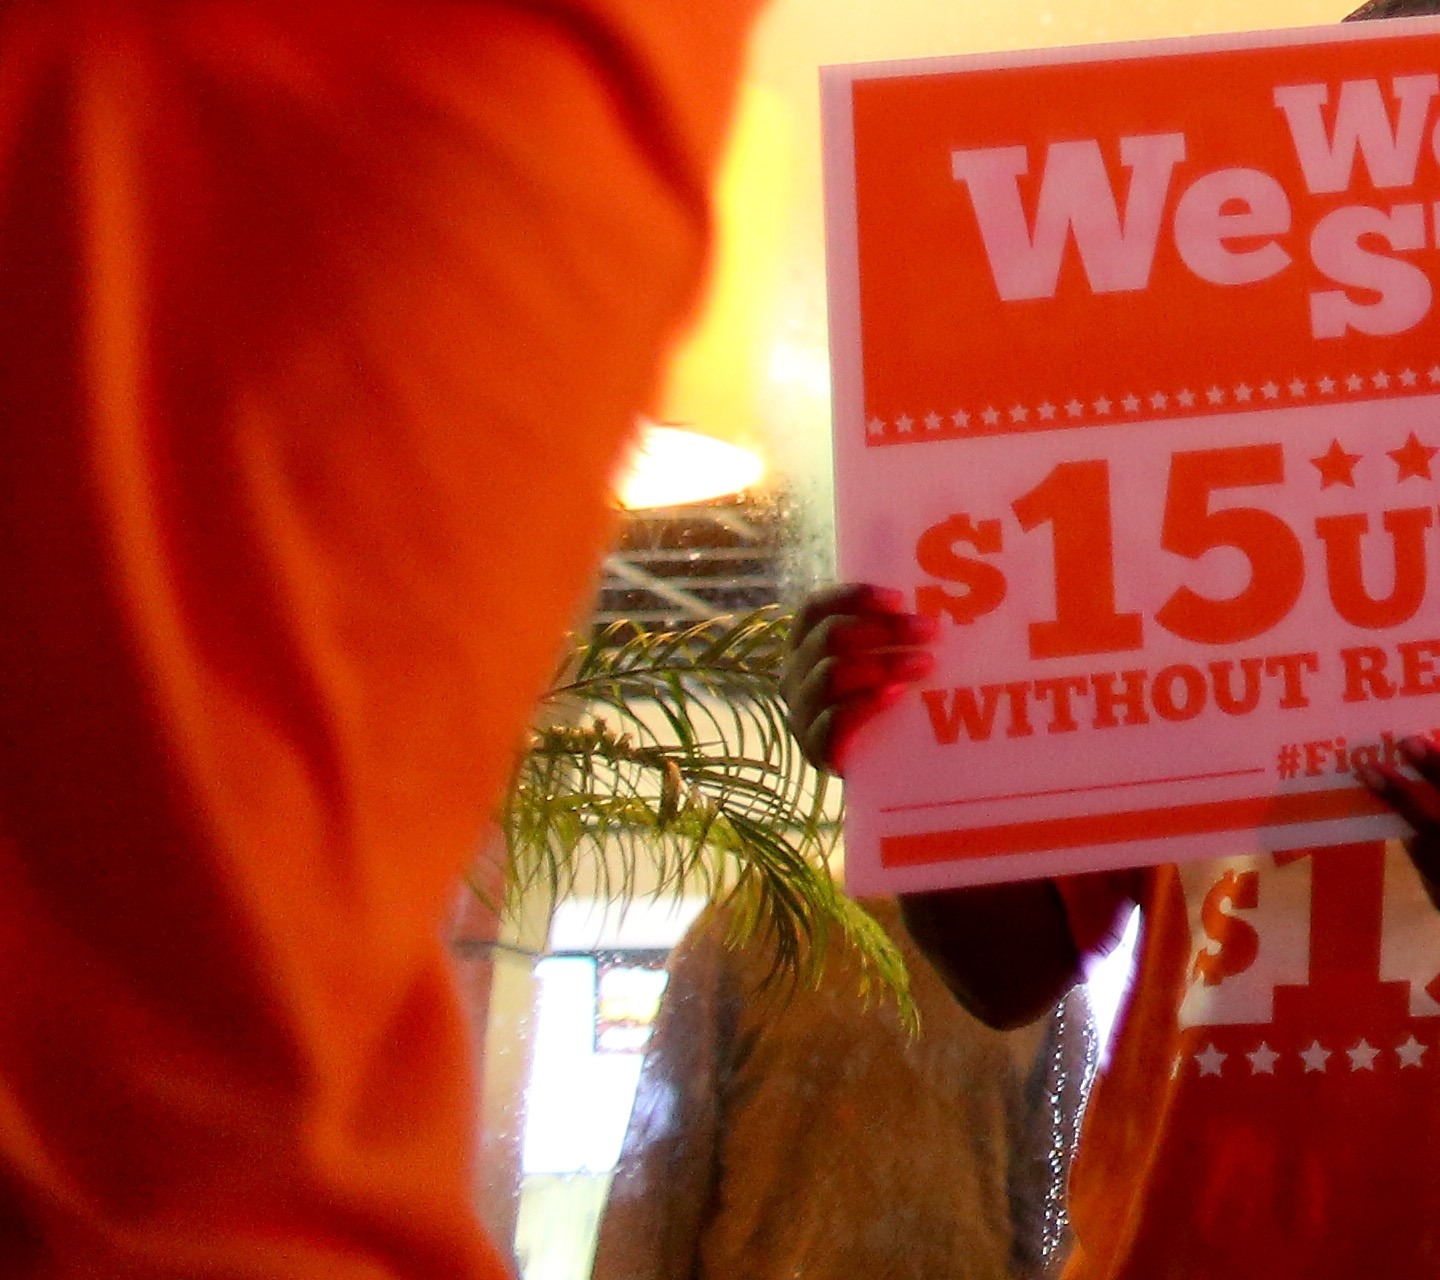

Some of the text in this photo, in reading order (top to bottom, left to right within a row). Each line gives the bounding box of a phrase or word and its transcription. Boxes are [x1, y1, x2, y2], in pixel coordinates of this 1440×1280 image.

[951, 131, 1292, 303] We
[914, 441, 1306, 661] $15
[920, 651, 1321, 745] WITHOUT
